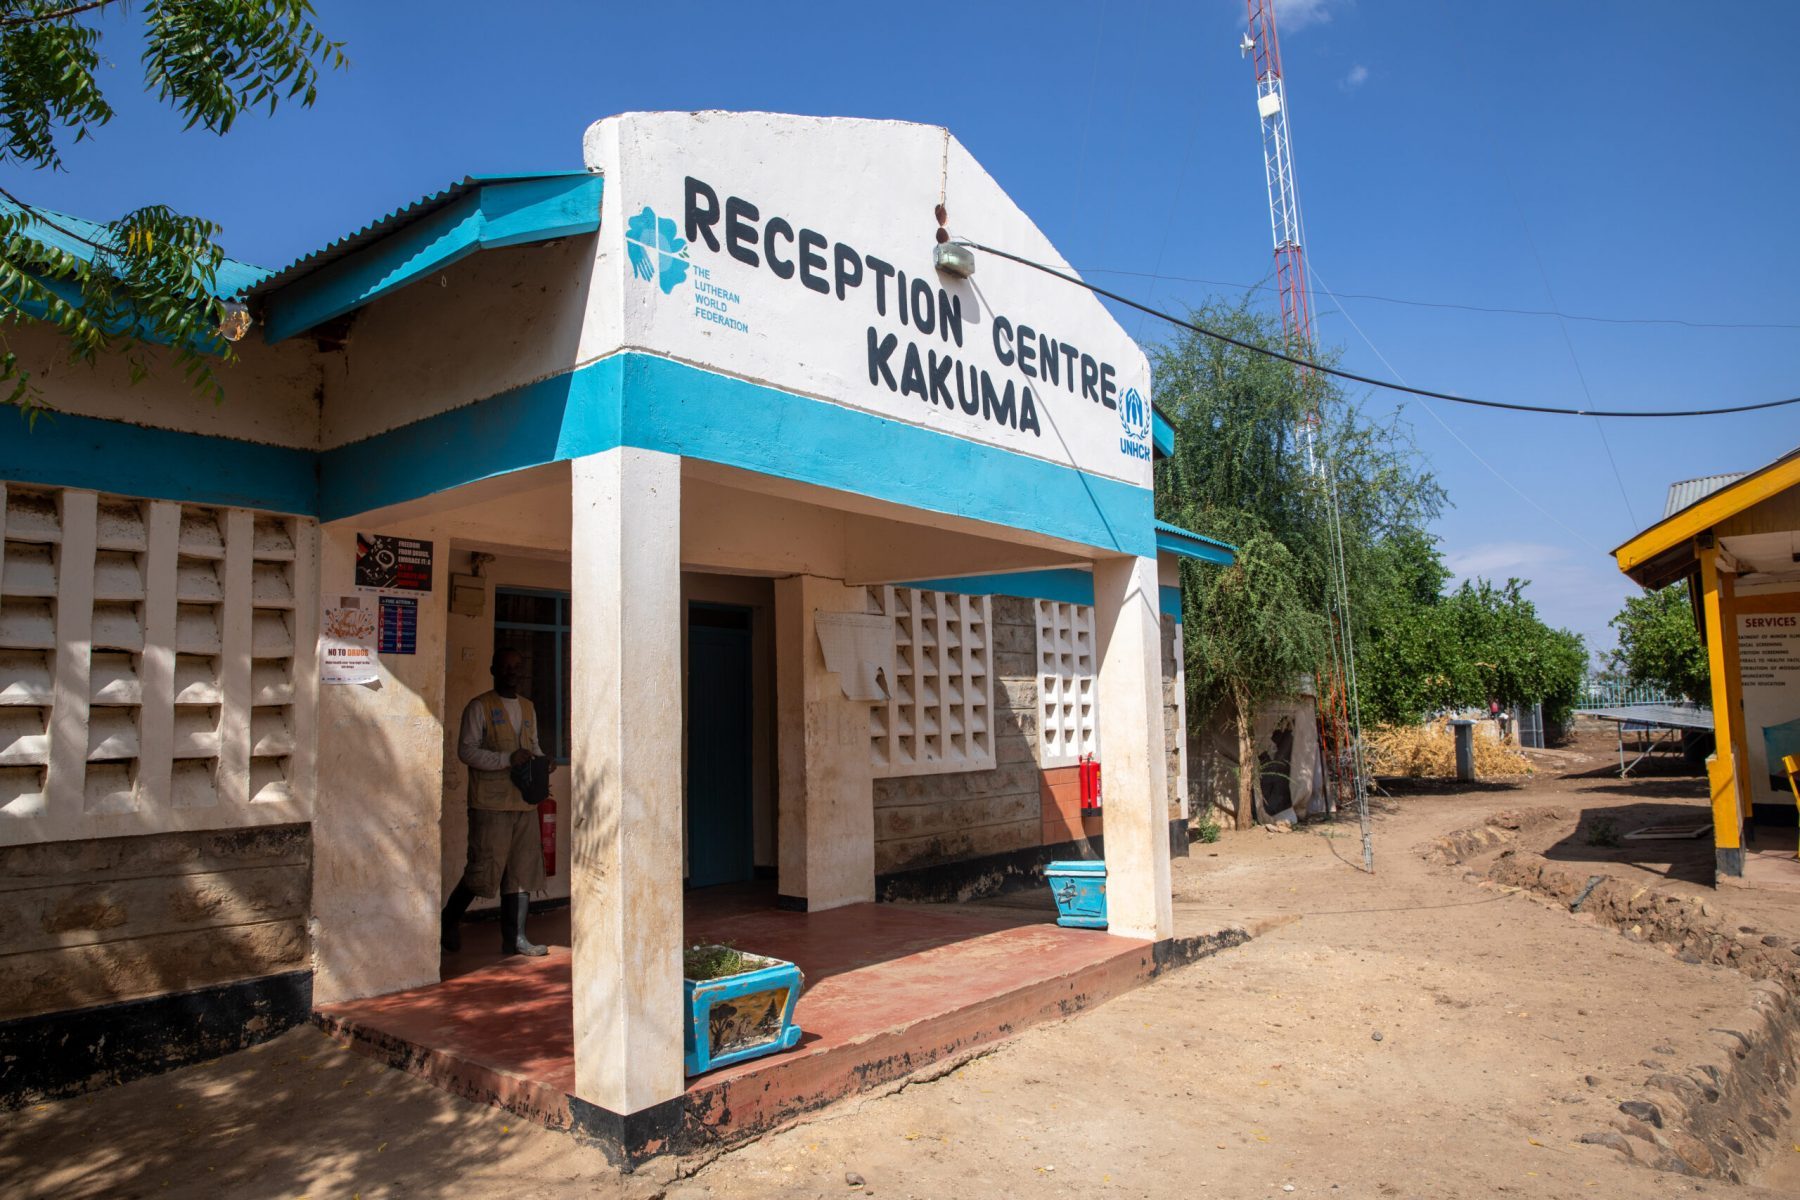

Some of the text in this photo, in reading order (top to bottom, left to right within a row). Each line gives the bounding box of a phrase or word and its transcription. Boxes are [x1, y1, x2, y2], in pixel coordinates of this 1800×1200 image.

[693, 264, 711, 280] THE
[684, 175, 1117, 411] RECEPTION CENTRE
[694, 280, 740, 305] LUTHERAN
[695, 293, 728, 313] WORLD
[695, 307, 749, 333] FEDERATION
[867, 326, 1041, 437] KAKUMA
[1120, 437, 1151, 463] UNHCR
[1745, 616, 1797, 628] SERVICES
[328, 648, 369, 656] NO TO DRUGS
